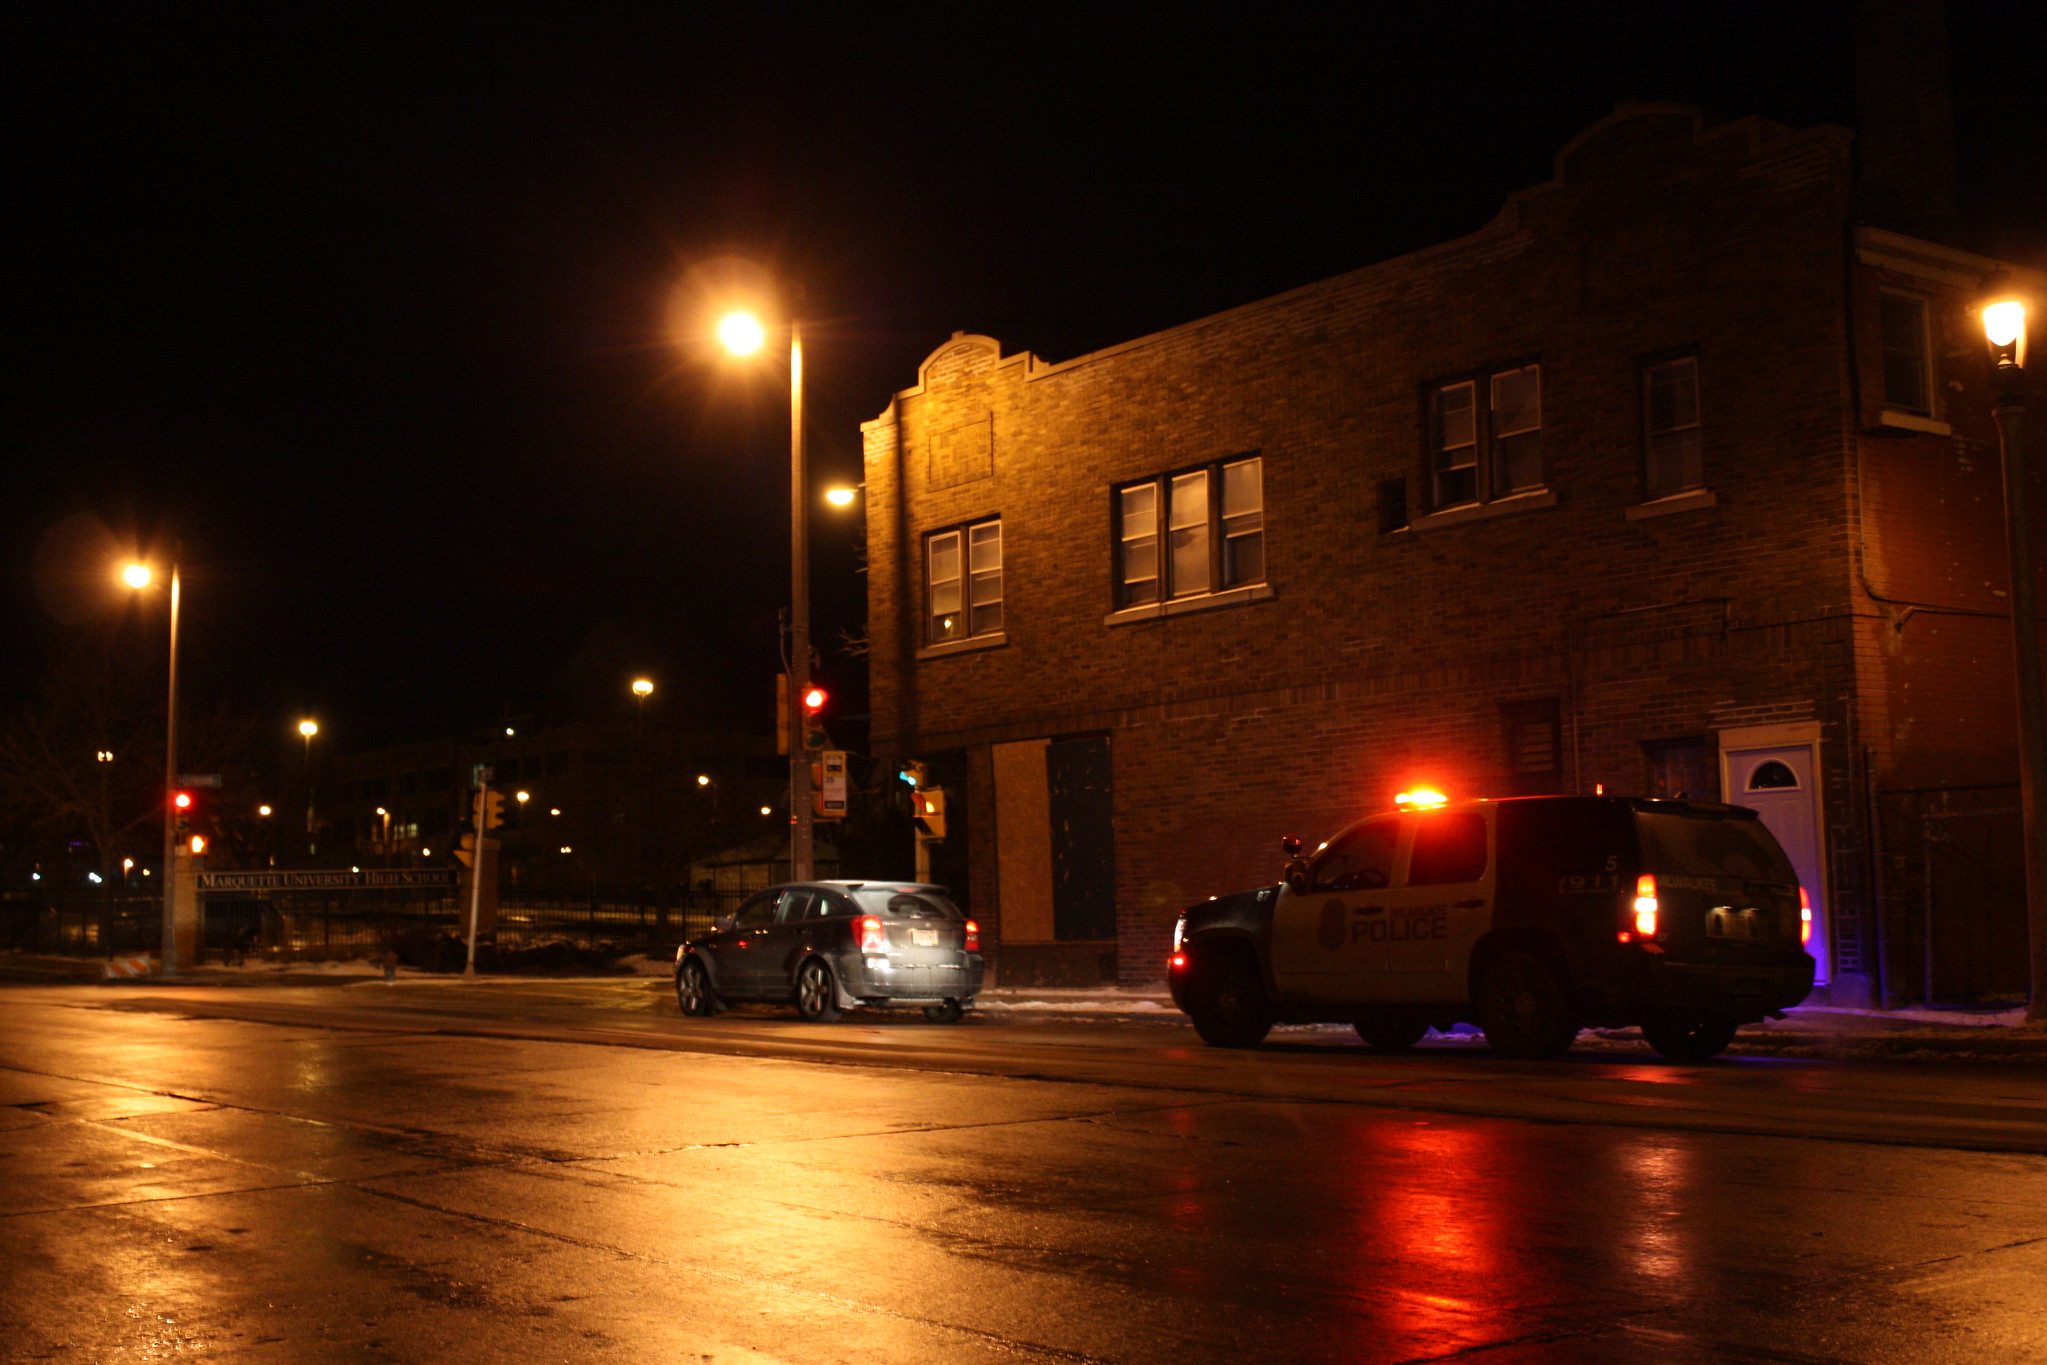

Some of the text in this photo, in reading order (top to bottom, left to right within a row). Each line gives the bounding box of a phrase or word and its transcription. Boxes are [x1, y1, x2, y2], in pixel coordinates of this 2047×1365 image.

[1604, 854, 1618, 872] 5
[202, 870, 449, 889] MARQUETTE UNIVERSITY HIGH SCHOOL
[1256, 890, 1270, 902] 87
[1351, 917, 1447, 942] POLICE
